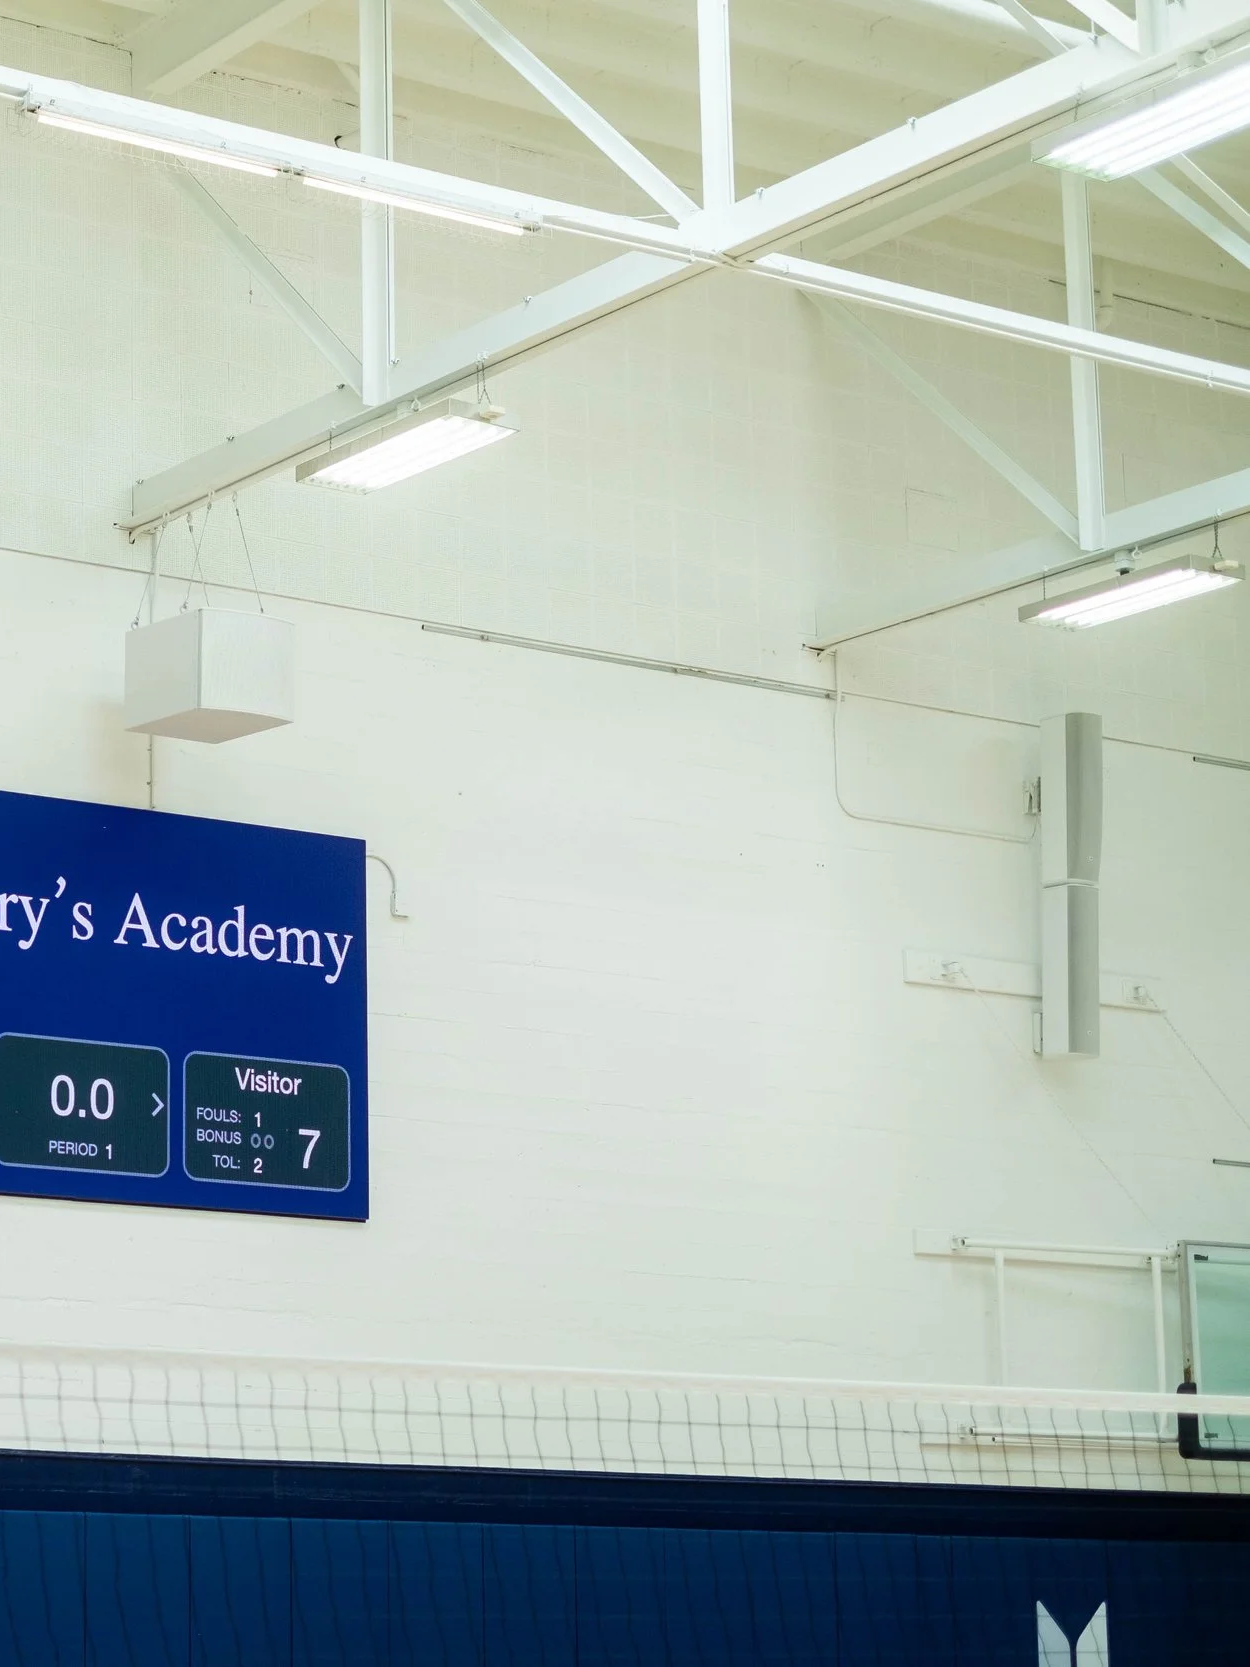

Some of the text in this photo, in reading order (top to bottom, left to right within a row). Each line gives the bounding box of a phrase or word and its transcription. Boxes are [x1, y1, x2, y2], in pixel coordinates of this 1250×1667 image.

[113, 892, 354, 985] Academy
[234, 1066, 303, 1096] Visitor
[50, 1074, 115, 1120] 0.0
[196, 1106, 261, 1128] FOULS: 1
[196, 1128, 242, 1145] BONUS
[298, 1128, 321, 1169] 7
[48, 1140, 112, 1160] PERIOD 1
[211, 1154, 263, 1174] TOL: 2
